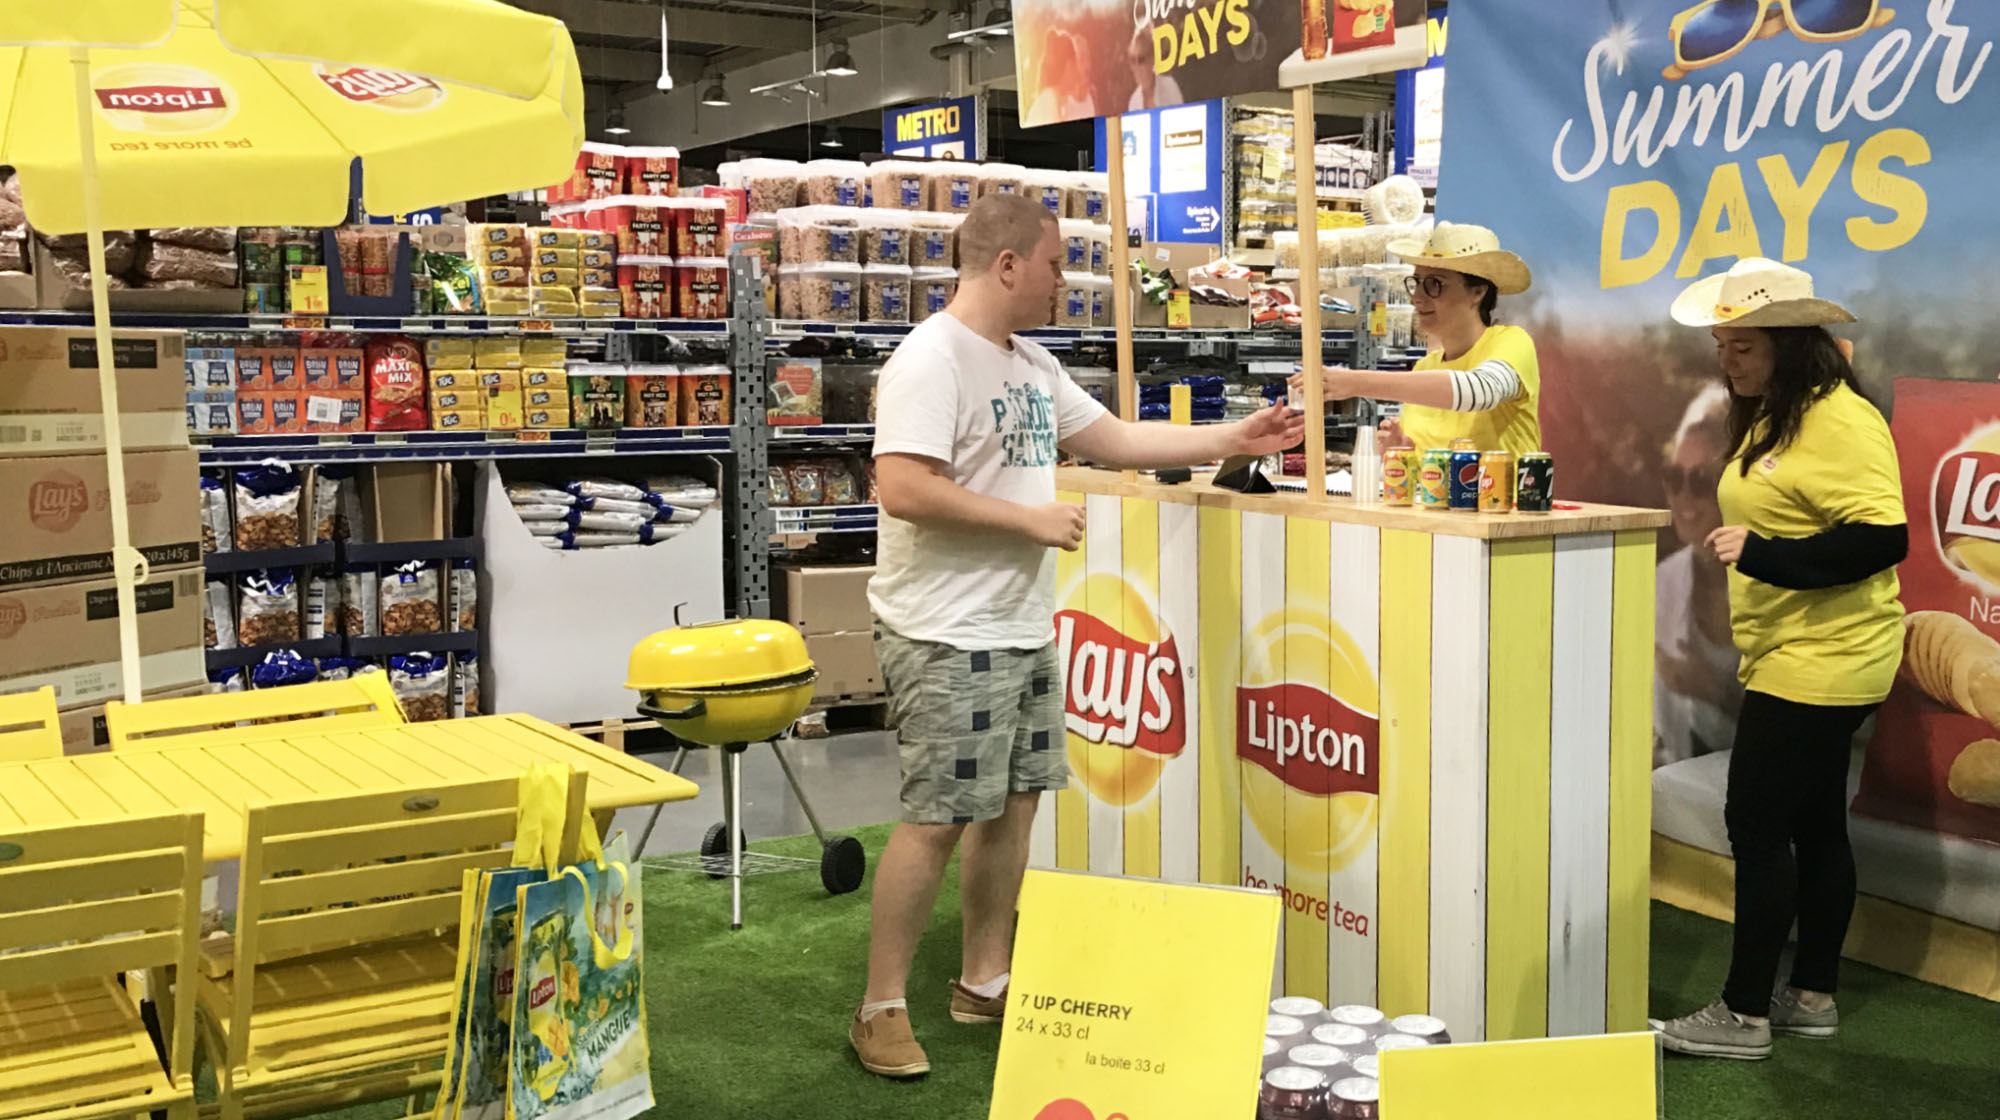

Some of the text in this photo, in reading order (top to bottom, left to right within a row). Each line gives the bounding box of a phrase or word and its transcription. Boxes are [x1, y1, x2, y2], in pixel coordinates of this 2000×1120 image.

[1153, 0, 1249, 75] DAYS
[1553, 0, 1993, 182] Summer
[897, 106, 960, 142] METRO
[1601, 128, 1932, 290] DAYS
[632, 222, 649, 230] PARTY
[376, 358, 410, 374] MAXI
[388, 372, 412, 384] MIX
[0, 565, 33, 580] Chips
[47, 558, 103, 575] l'Ancienne
[1249, 700, 1366, 775] Lipton
[1274, 883, 1328, 921] more
[1334, 901, 1368, 937] tea
[1020, 993, 1132, 1021] 7 UP CHERRY
[586, 1009, 631, 1065] MANGUE
[1016, 1016, 1090, 1040] 24 x 33 cl
[1085, 1051, 1097, 1066] la
[1135, 1058, 1151, 1073] 33
[1154, 1062, 1165, 1075] cl
